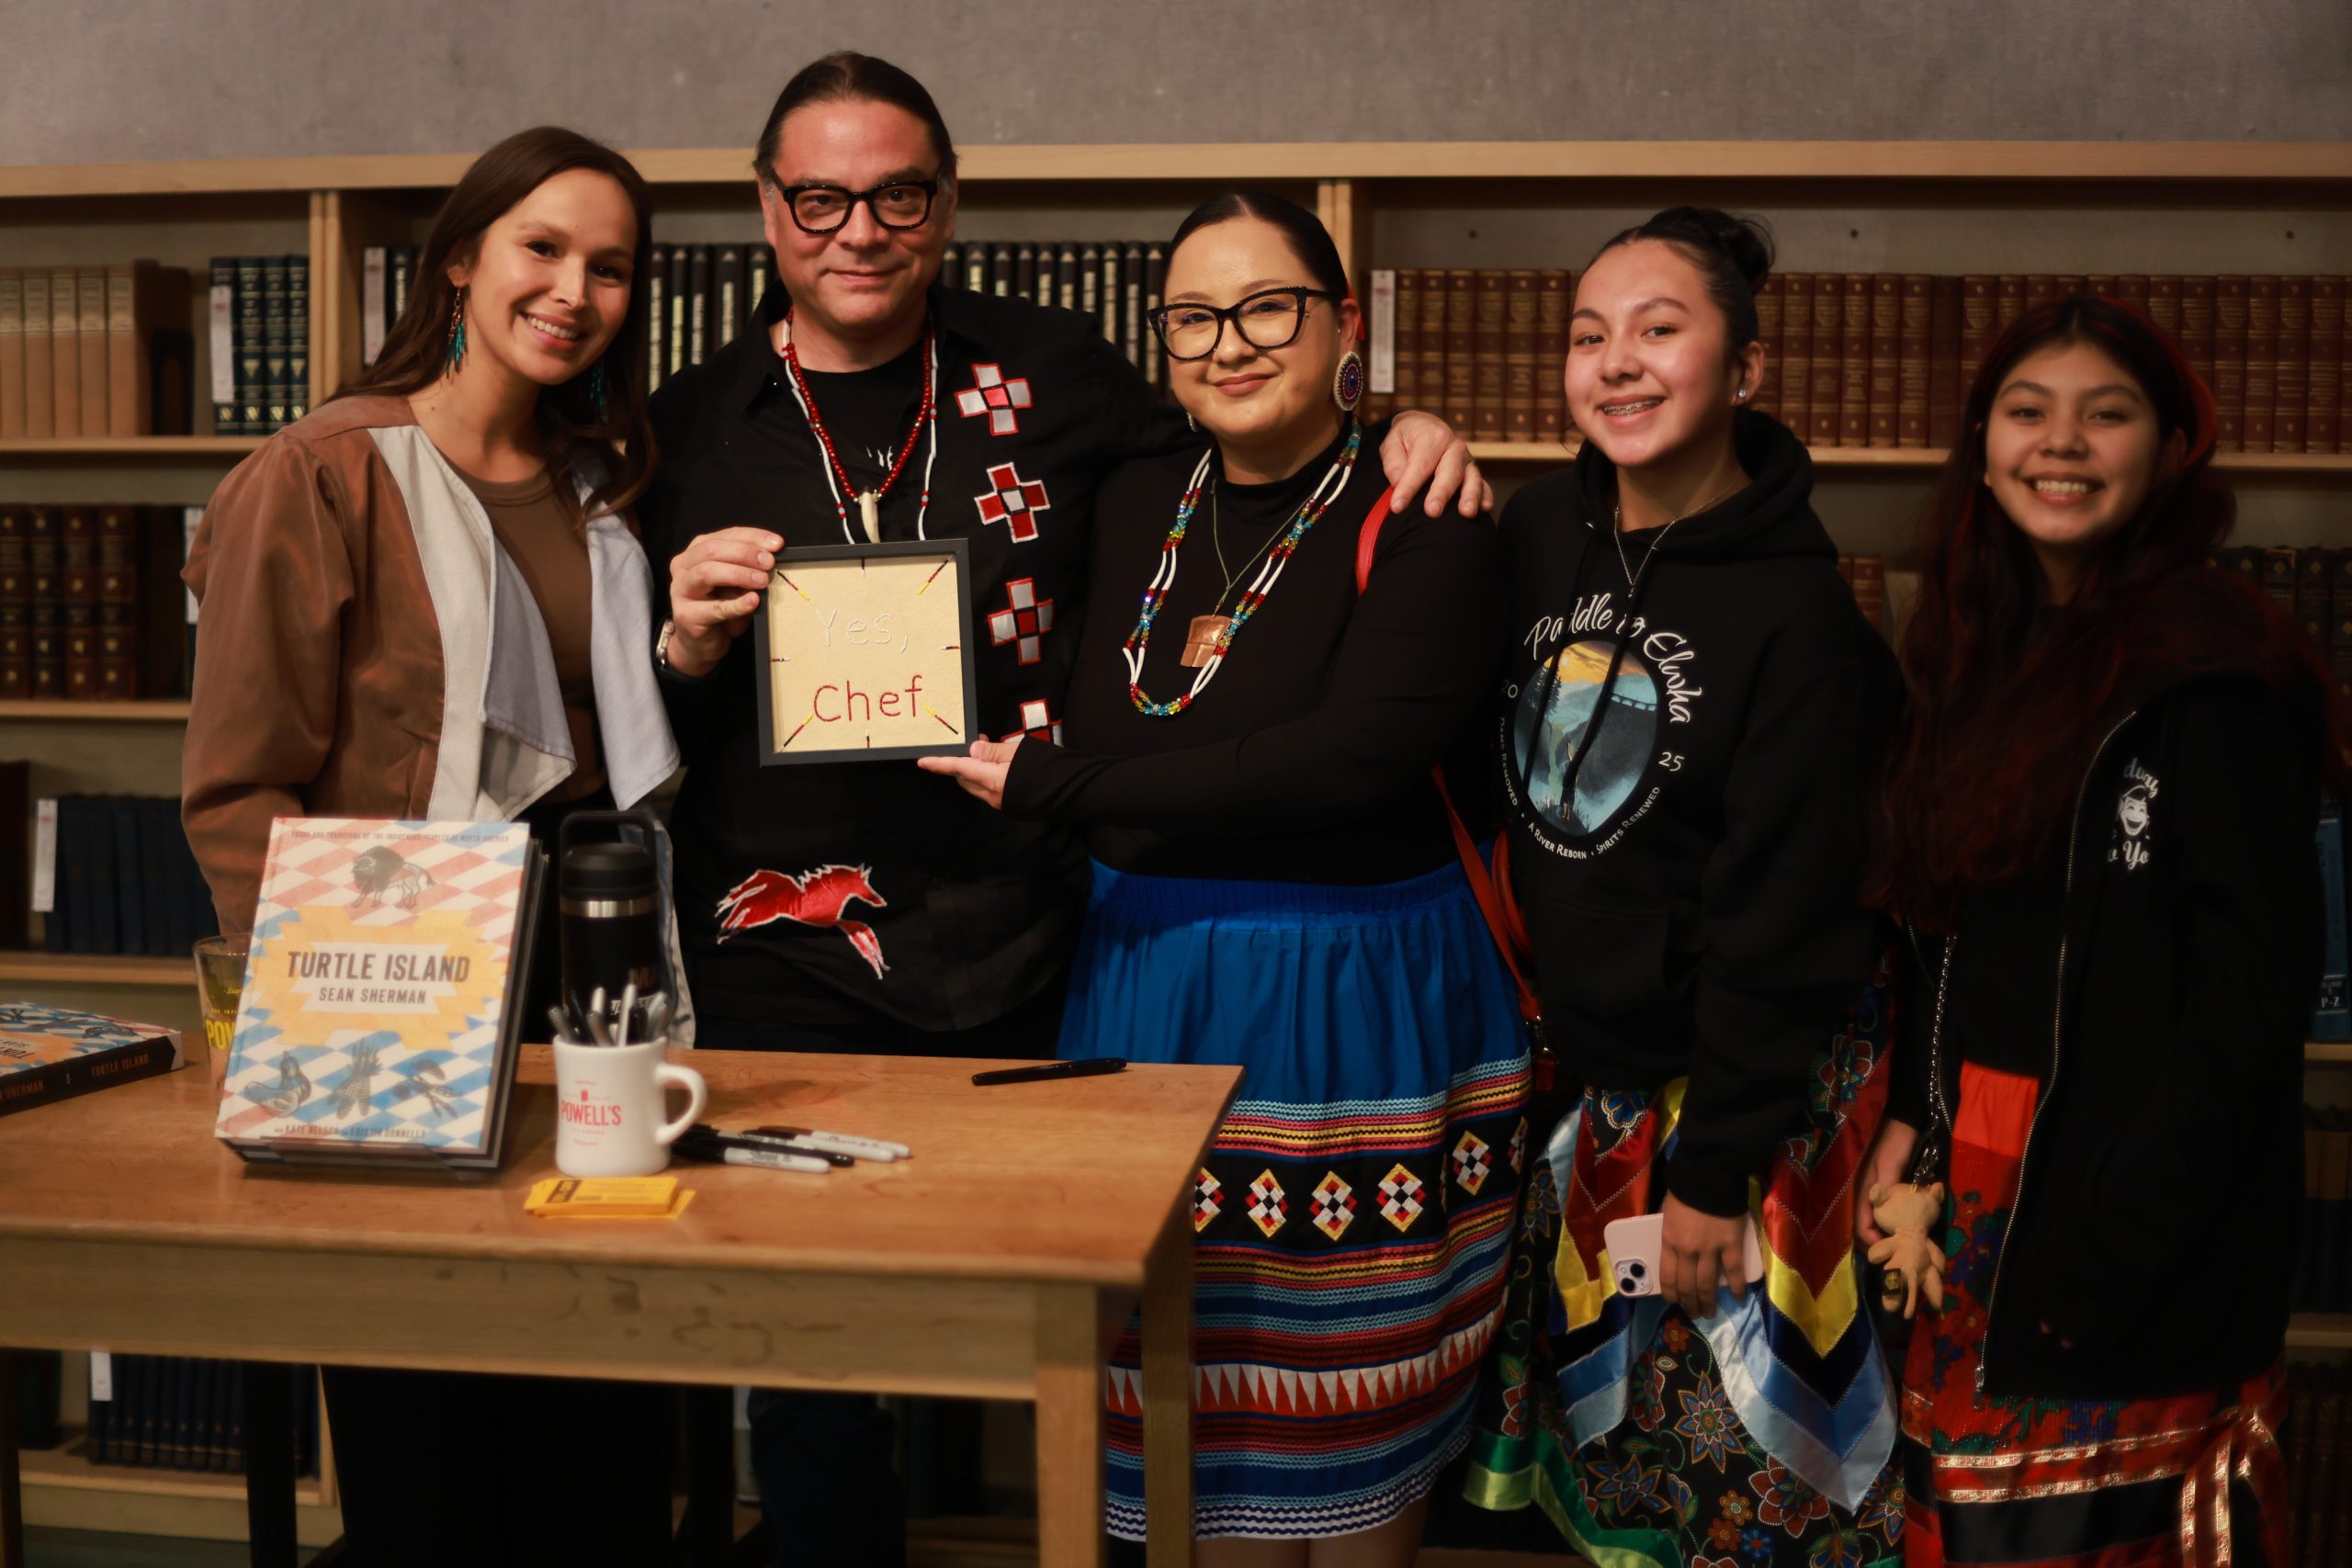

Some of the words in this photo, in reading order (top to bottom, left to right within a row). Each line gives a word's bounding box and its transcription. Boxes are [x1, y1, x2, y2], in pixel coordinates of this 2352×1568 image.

[816, 609, 910, 654] Yes,
[813, 674, 922, 722] Chef
[1658, 751, 1685, 773] 25
[1595, 828, 1624, 855] SPIRITS
[1621, 786, 1661, 829] RENEWED
[1556, 843, 1588, 860] REBORN
[288, 951, 377, 980] TURTLE
[384, 954, 470, 983] ISLAND
[319, 987, 355, 1002] SEAN
[361, 988, 426, 1004] SHERMAN
[90, 1060, 119, 1077] TURTLE
[121, 1054, 150, 1070] ISLAND
[560, 1100, 622, 1126] POWELL'S
